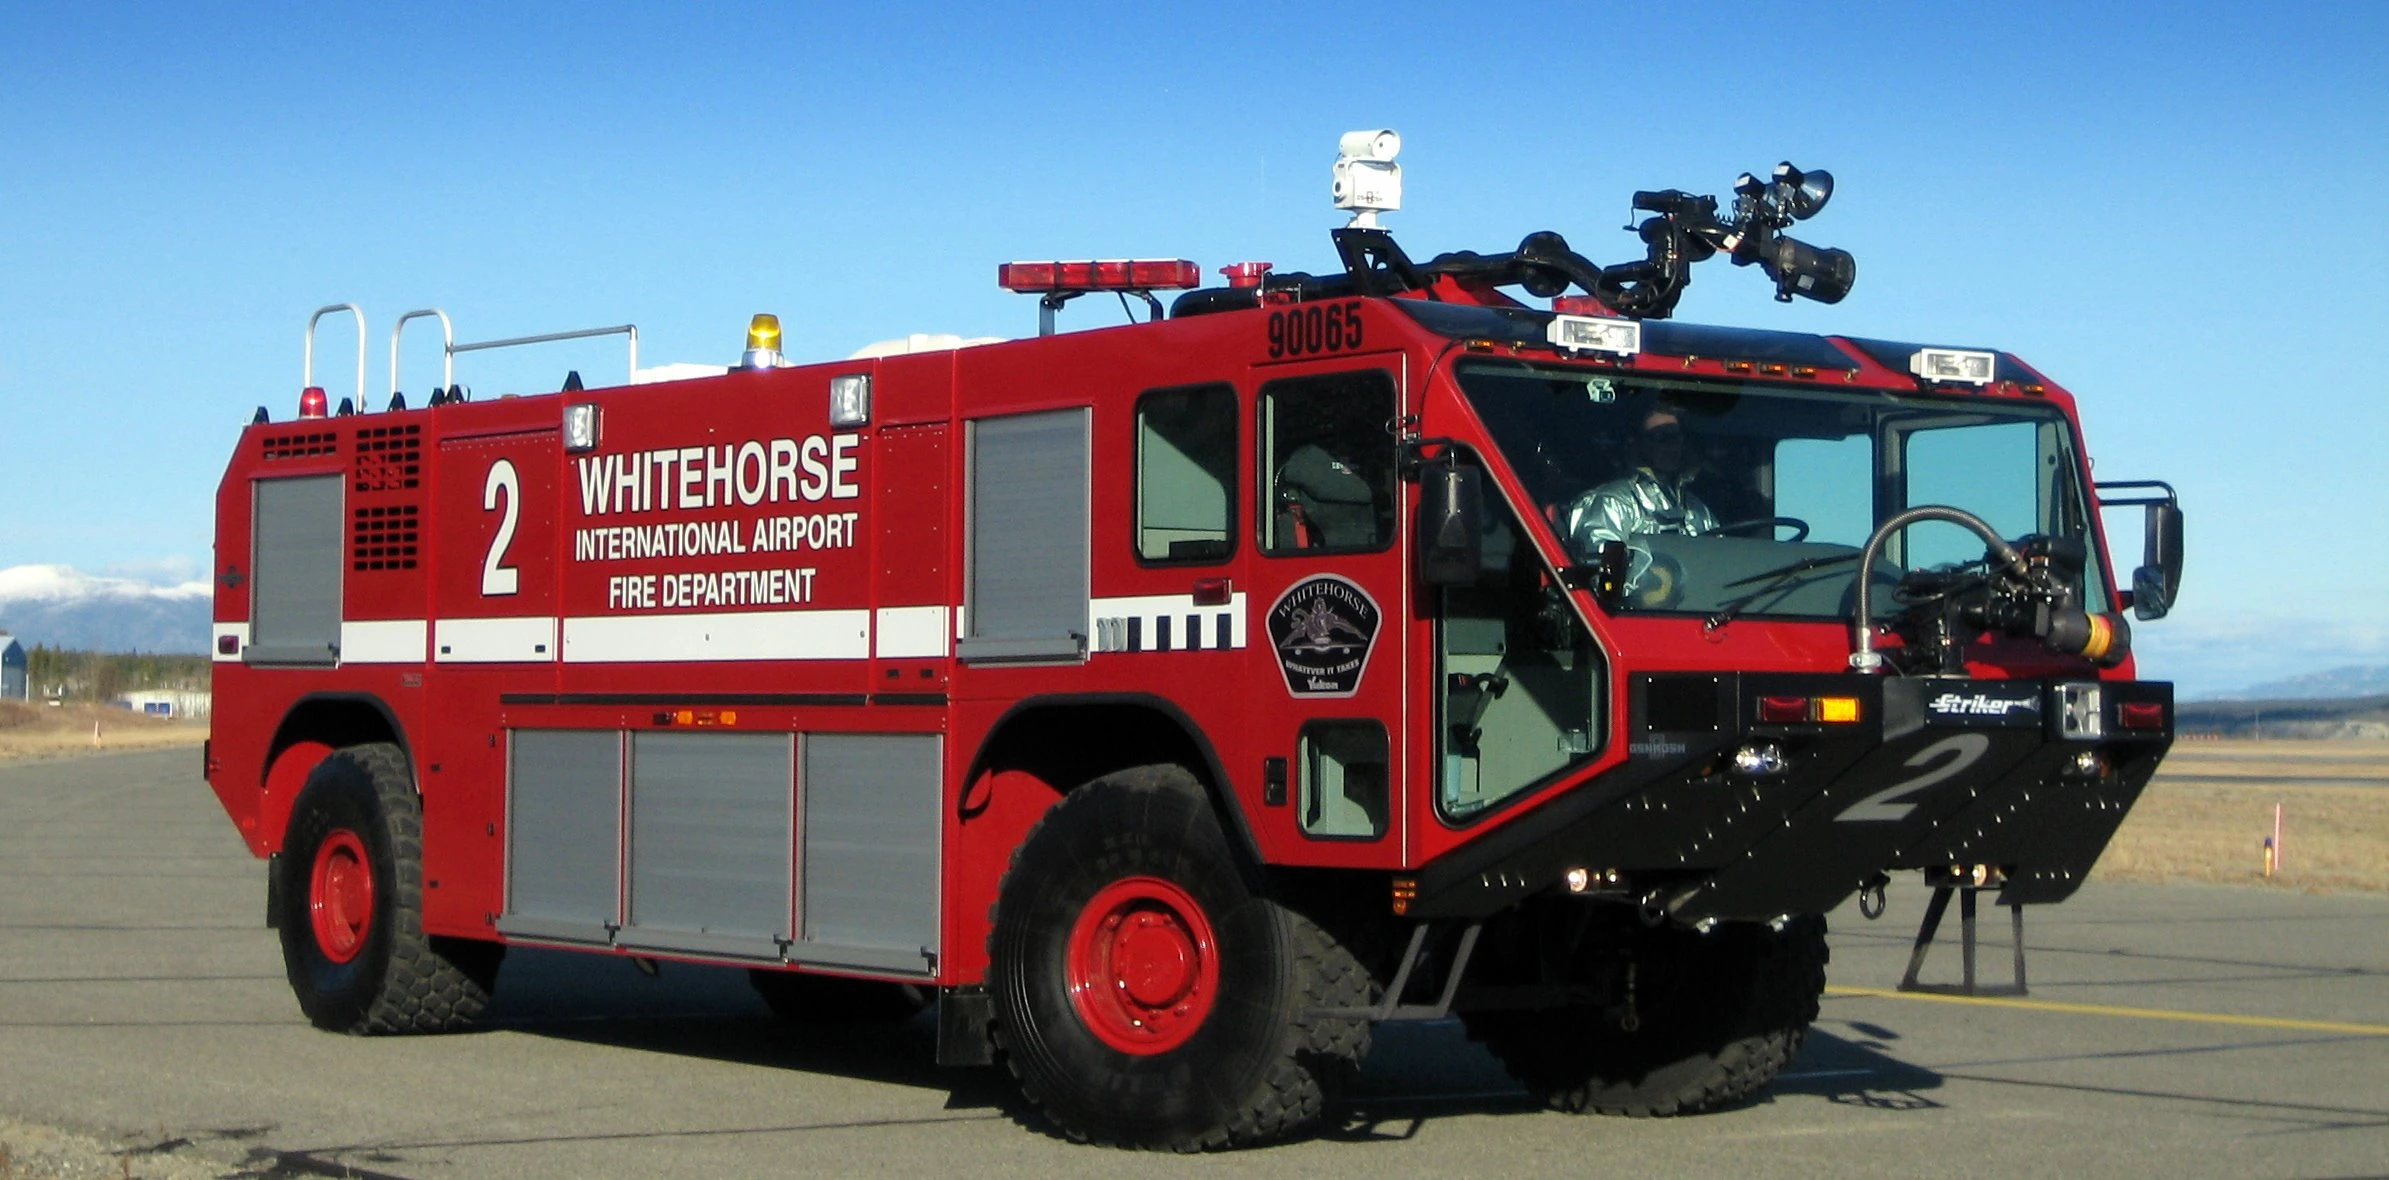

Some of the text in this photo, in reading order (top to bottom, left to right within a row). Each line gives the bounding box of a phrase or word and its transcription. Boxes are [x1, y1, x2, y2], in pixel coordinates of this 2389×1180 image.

[1268, 301, 1362, 358] 90065
[578, 433, 859, 516] WHITEHORSE
[481, 458, 520, 596] 2
[575, 512, 859, 562] INTERNATIONAL AIRPORT
[609, 568, 816, 609] FIRE DEPARTMENT
[1279, 583, 1368, 619] WHITEHORSE
[1285, 659, 1359, 675] WHATEVER IT TAKES
[1307, 676, 1339, 690] Yukon
[1929, 693, 2013, 714] Striker
[1833, 733, 1989, 822] 2
